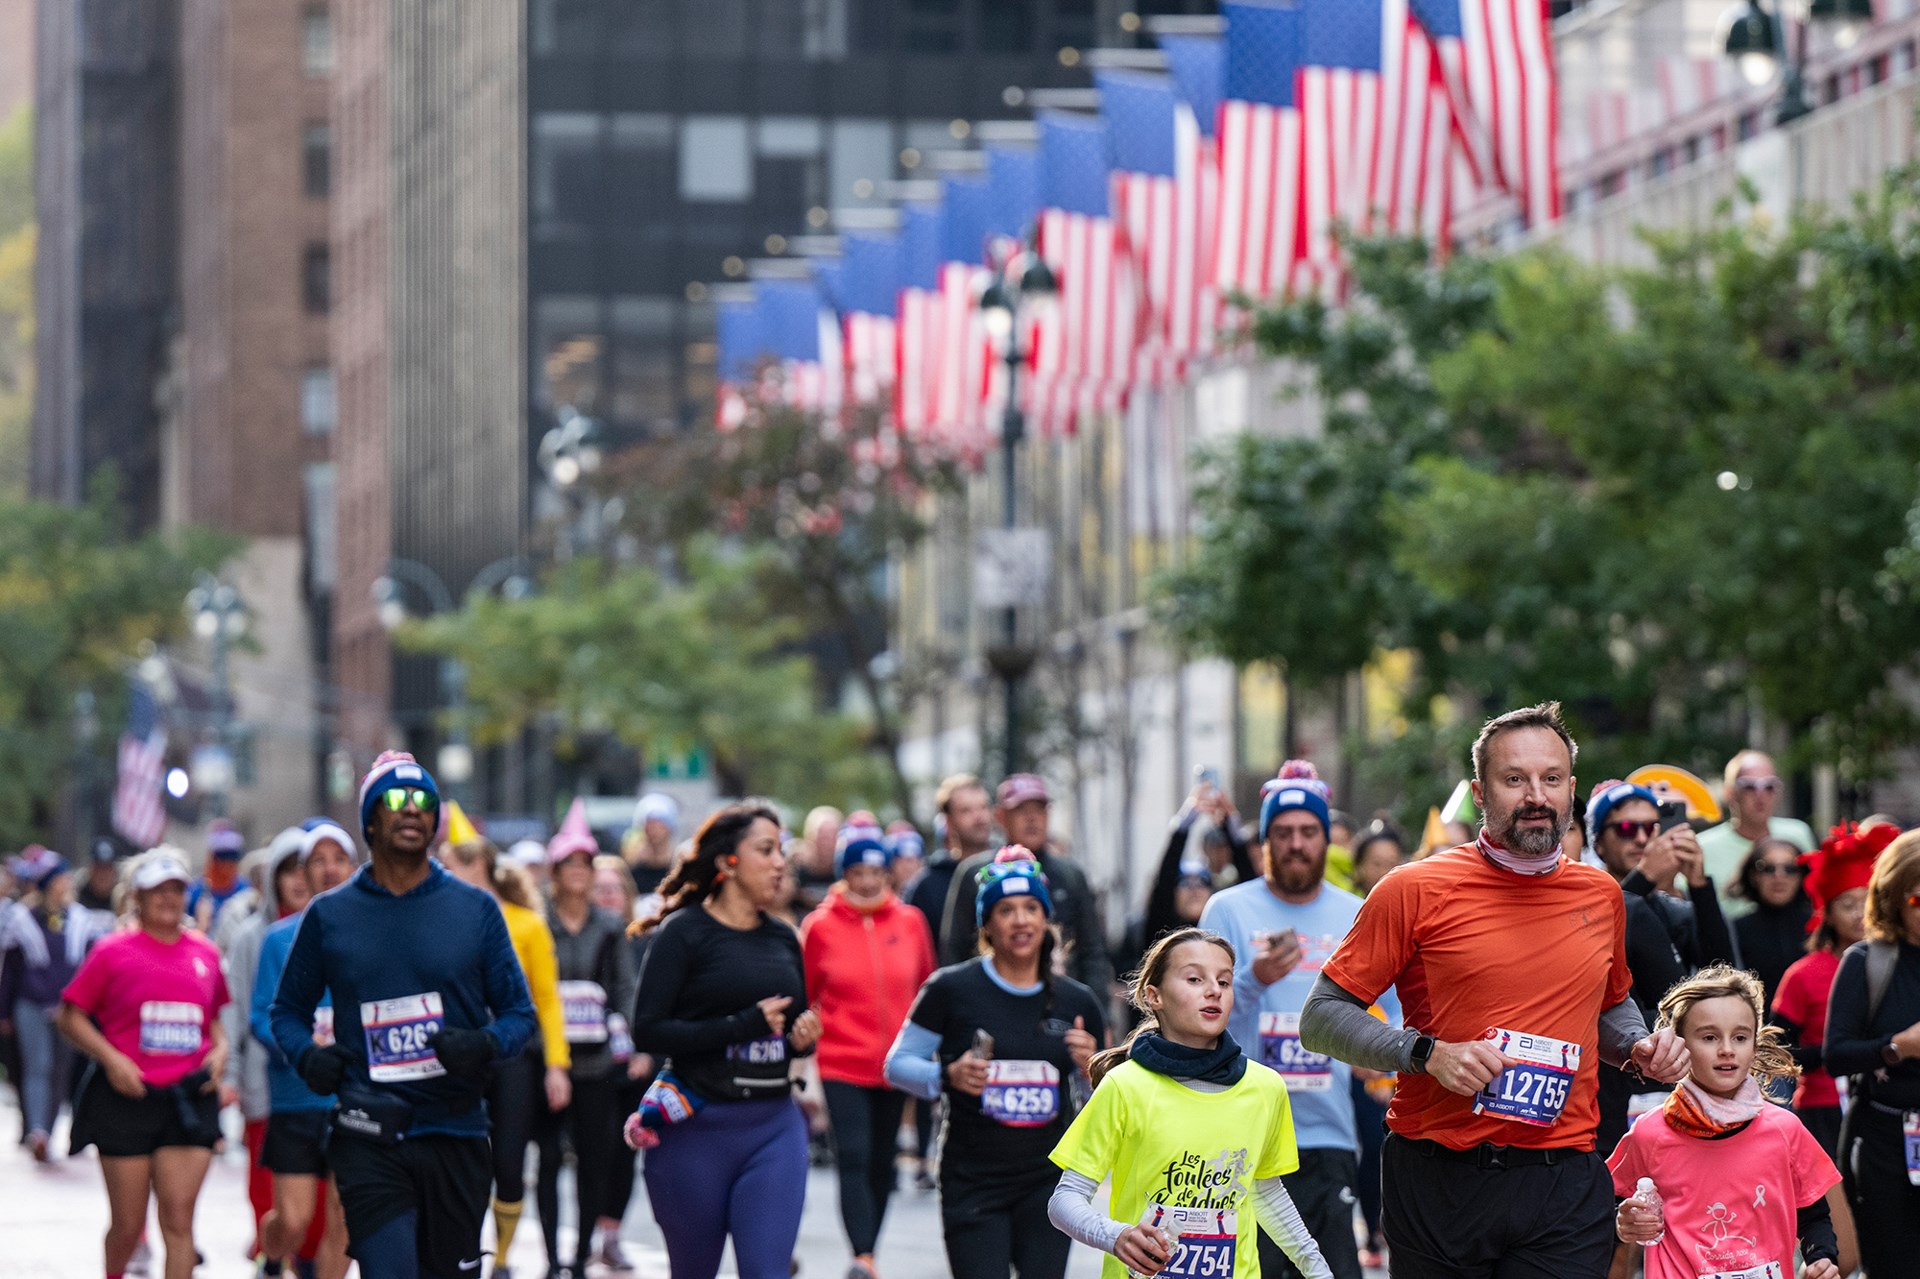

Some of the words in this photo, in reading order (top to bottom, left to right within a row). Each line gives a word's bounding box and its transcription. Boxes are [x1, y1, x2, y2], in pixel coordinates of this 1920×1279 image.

[369, 1031, 385, 1054] K
[1004, 1087, 1054, 1114] 6259
[1501, 1069, 1570, 1110] 12755
[1179, 1150, 1201, 1169] Les
[1162, 1160, 1232, 1194] foulées
[1177, 1187, 1195, 1202] de
[1164, 1243, 1231, 1277] 2754
